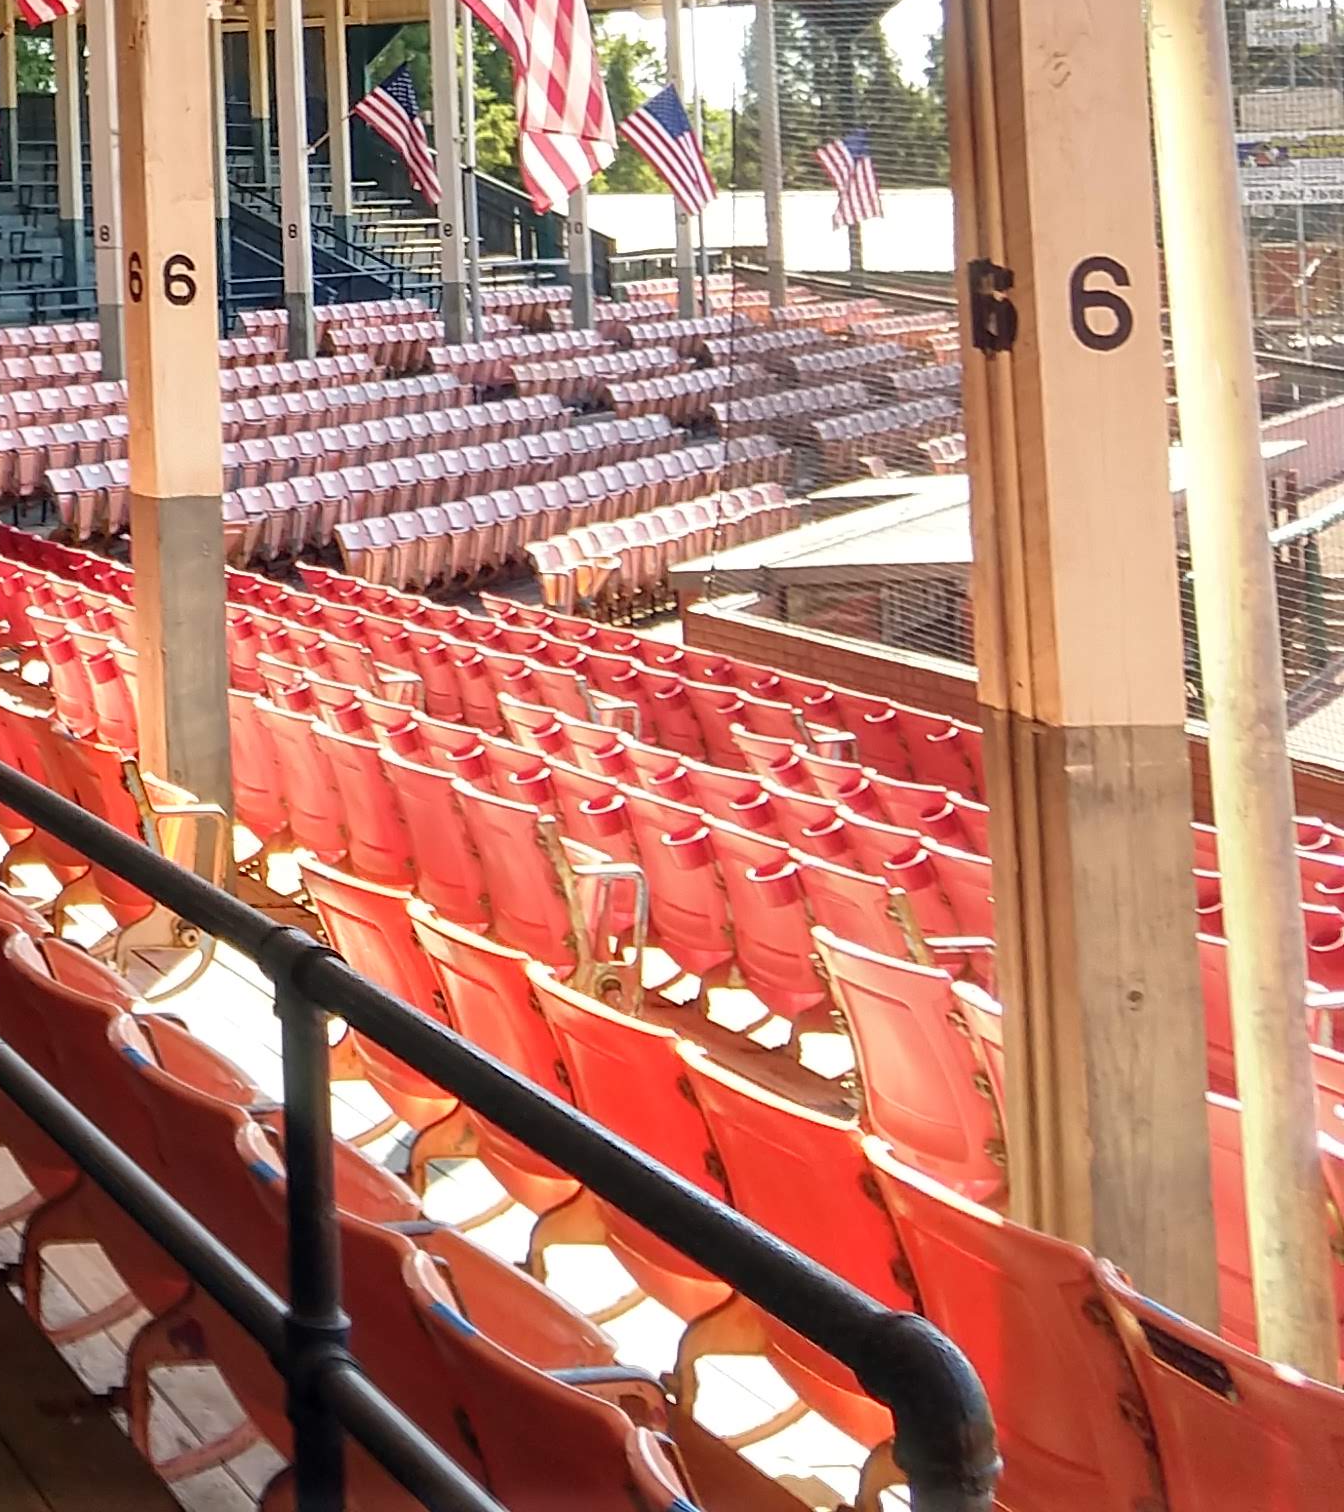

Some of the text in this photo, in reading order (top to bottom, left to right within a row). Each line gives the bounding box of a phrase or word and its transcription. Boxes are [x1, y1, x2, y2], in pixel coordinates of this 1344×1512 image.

[99, 224, 110, 242] 8
[288, 223, 297, 238] 8
[129, 251, 143, 303] 6
[163, 254, 197, 306] 6
[968, 257, 1018, 356] 6
[1069, 255, 1134, 352] 6
